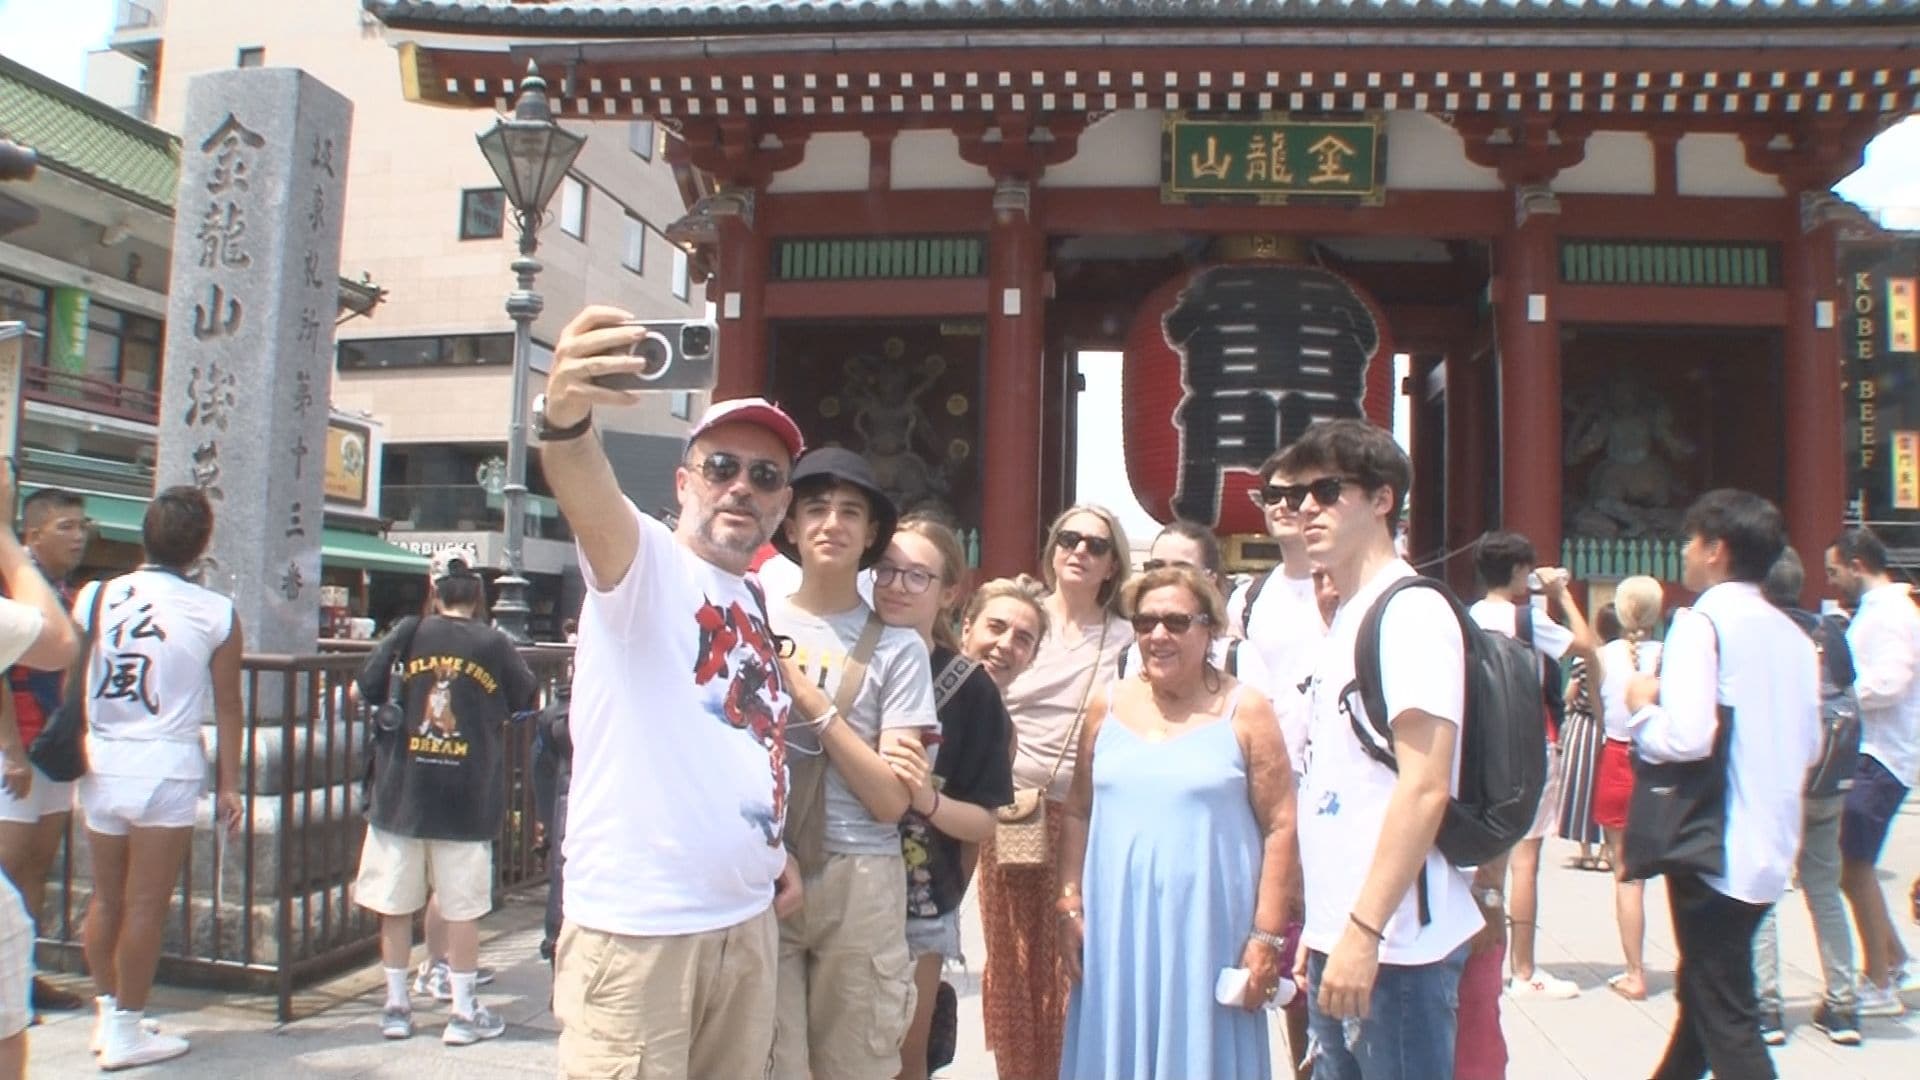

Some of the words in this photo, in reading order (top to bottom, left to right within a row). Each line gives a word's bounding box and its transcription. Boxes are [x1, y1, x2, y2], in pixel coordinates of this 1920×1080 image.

[1856, 271, 1874, 359] KOBE
[1858, 380, 1876, 469] BEEF
[409, 655, 464, 674] FLAME
[464, 662, 498, 694] FROM
[409, 737, 469, 756] DREAM
